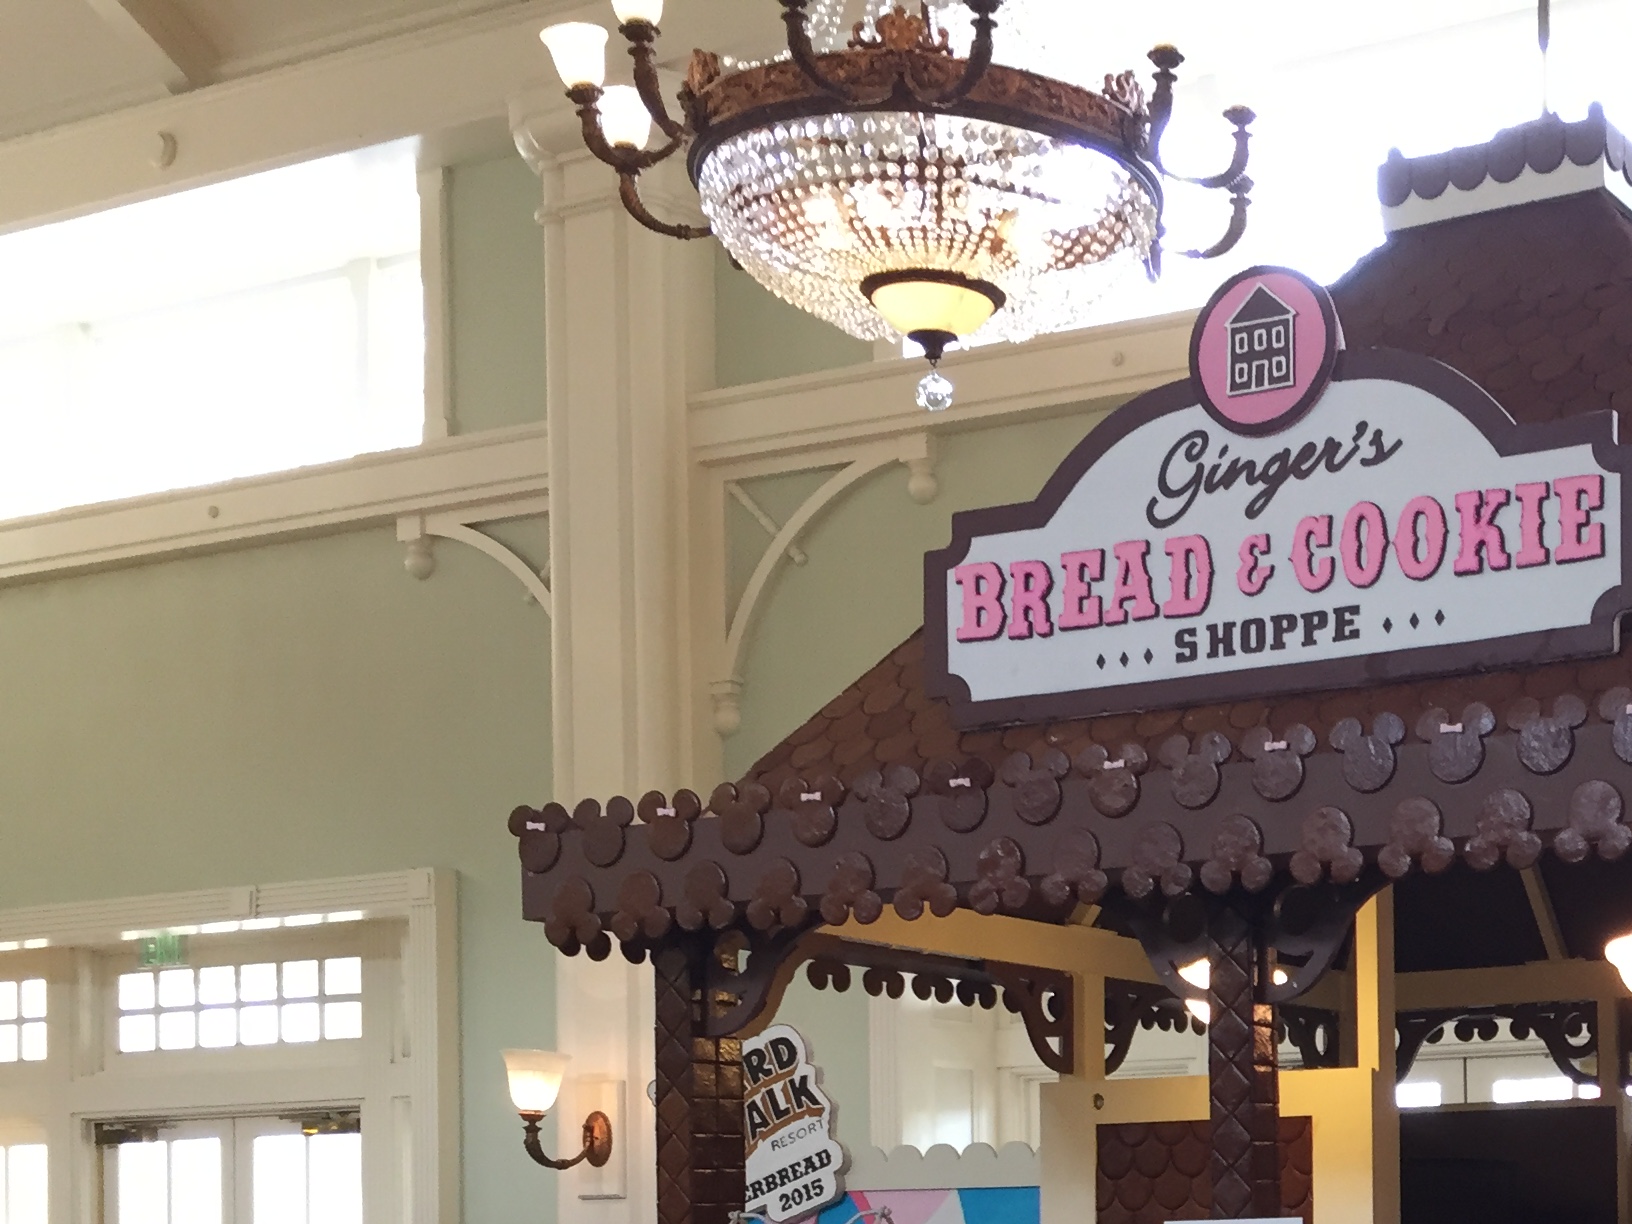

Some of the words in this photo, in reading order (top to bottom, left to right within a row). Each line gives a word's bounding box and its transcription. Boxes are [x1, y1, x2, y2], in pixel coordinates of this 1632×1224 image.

[1146, 420, 1403, 528] Ginger's
[955, 533, 1214, 643] BREAD
[1236, 533, 1274, 596] &
[1288, 474, 1606, 593] COOKIE
[1175, 605, 1361, 665] SHOPPE
[745, 1074, 824, 1147] ALK
[771, 1119, 824, 1152] RESORT
[778, 1178, 825, 1212] 2015
